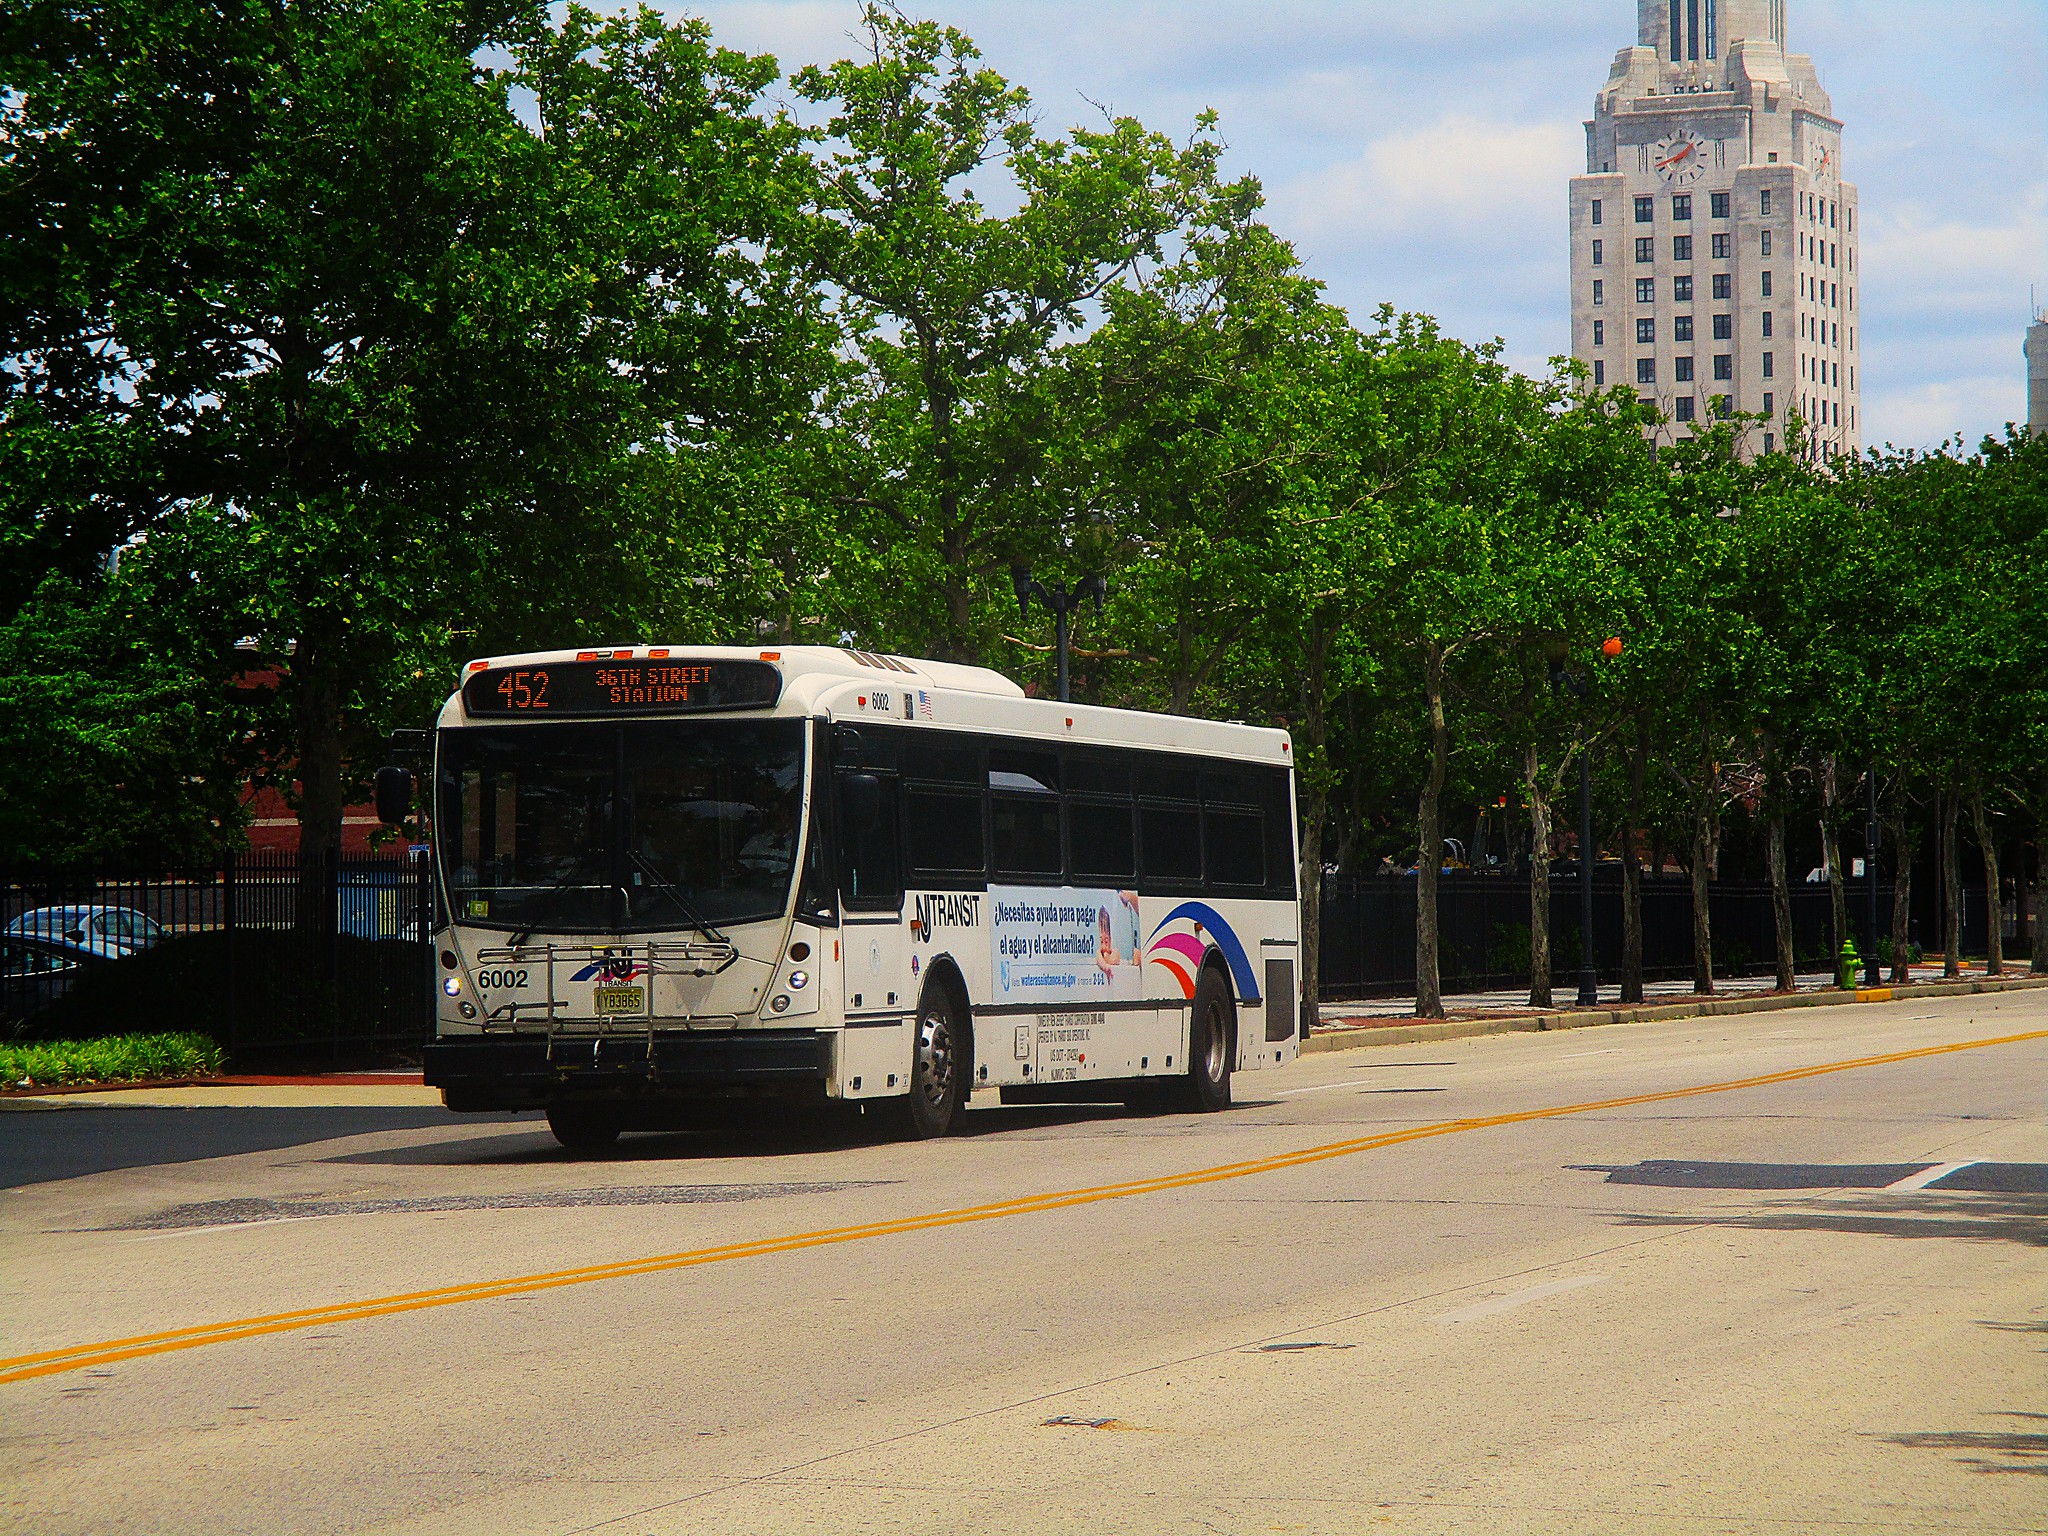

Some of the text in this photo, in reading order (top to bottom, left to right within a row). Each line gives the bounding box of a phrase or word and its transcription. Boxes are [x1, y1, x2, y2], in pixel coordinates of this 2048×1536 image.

[595, 666, 712, 686] 36TH STREET
[498, 671, 549, 708] 452
[610, 684, 688, 703] STATION
[871, 692, 889, 711] 6002
[930, 895, 980, 927] TRANSIT
[994, 901, 1096, 927] ¿Necesitas ayuda para pagar
[1000, 933, 1095, 959] el agua y el alcantarillado?
[478, 969, 528, 989] 6002
